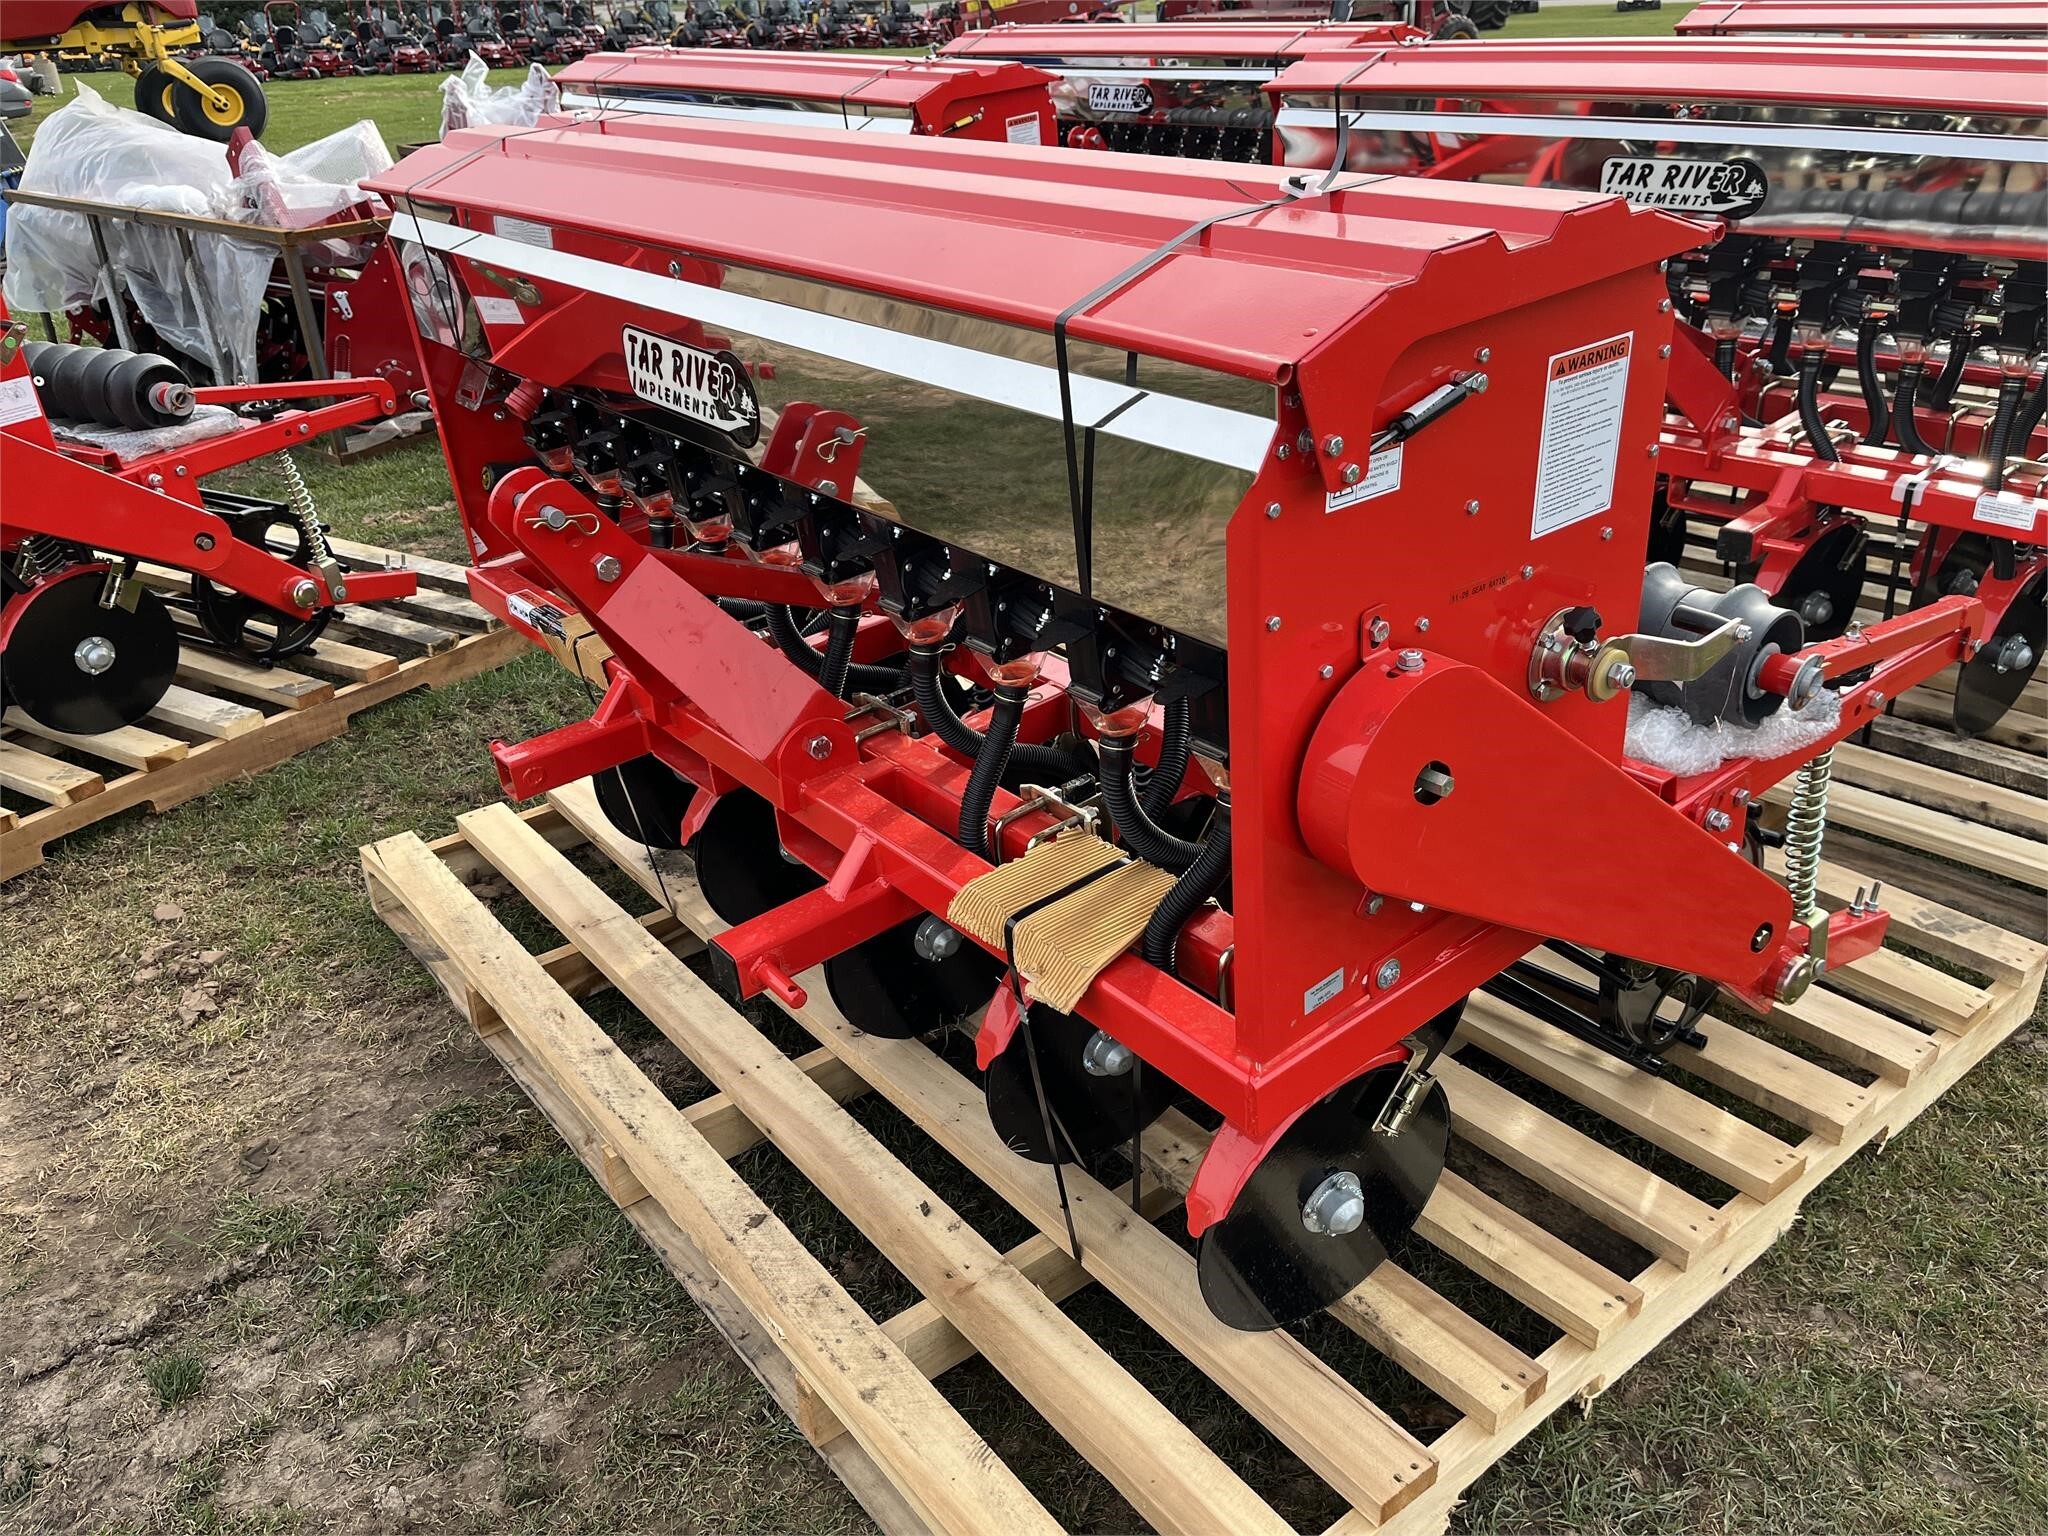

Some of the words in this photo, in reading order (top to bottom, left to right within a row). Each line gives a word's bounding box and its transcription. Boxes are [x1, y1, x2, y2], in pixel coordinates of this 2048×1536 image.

[1091, 100, 1133, 109] IMPLEMENTS
[1092, 87, 1109, 100] TAR
[1113, 87, 1145, 102] RIVER
[1607, 162, 1654, 189] TAR
[1661, 165, 1745, 195] RIVER
[1605, 187, 1711, 206] IPLEMENTS
[1568, 342, 1626, 372] WARNING
[628, 334, 663, 381] TAR
[672, 350, 735, 408] RIVER
[633, 370, 716, 420] IMPLEMENTS
[1472, 583, 1486, 595] GEAR
[1489, 576, 1506, 588] RATIO
